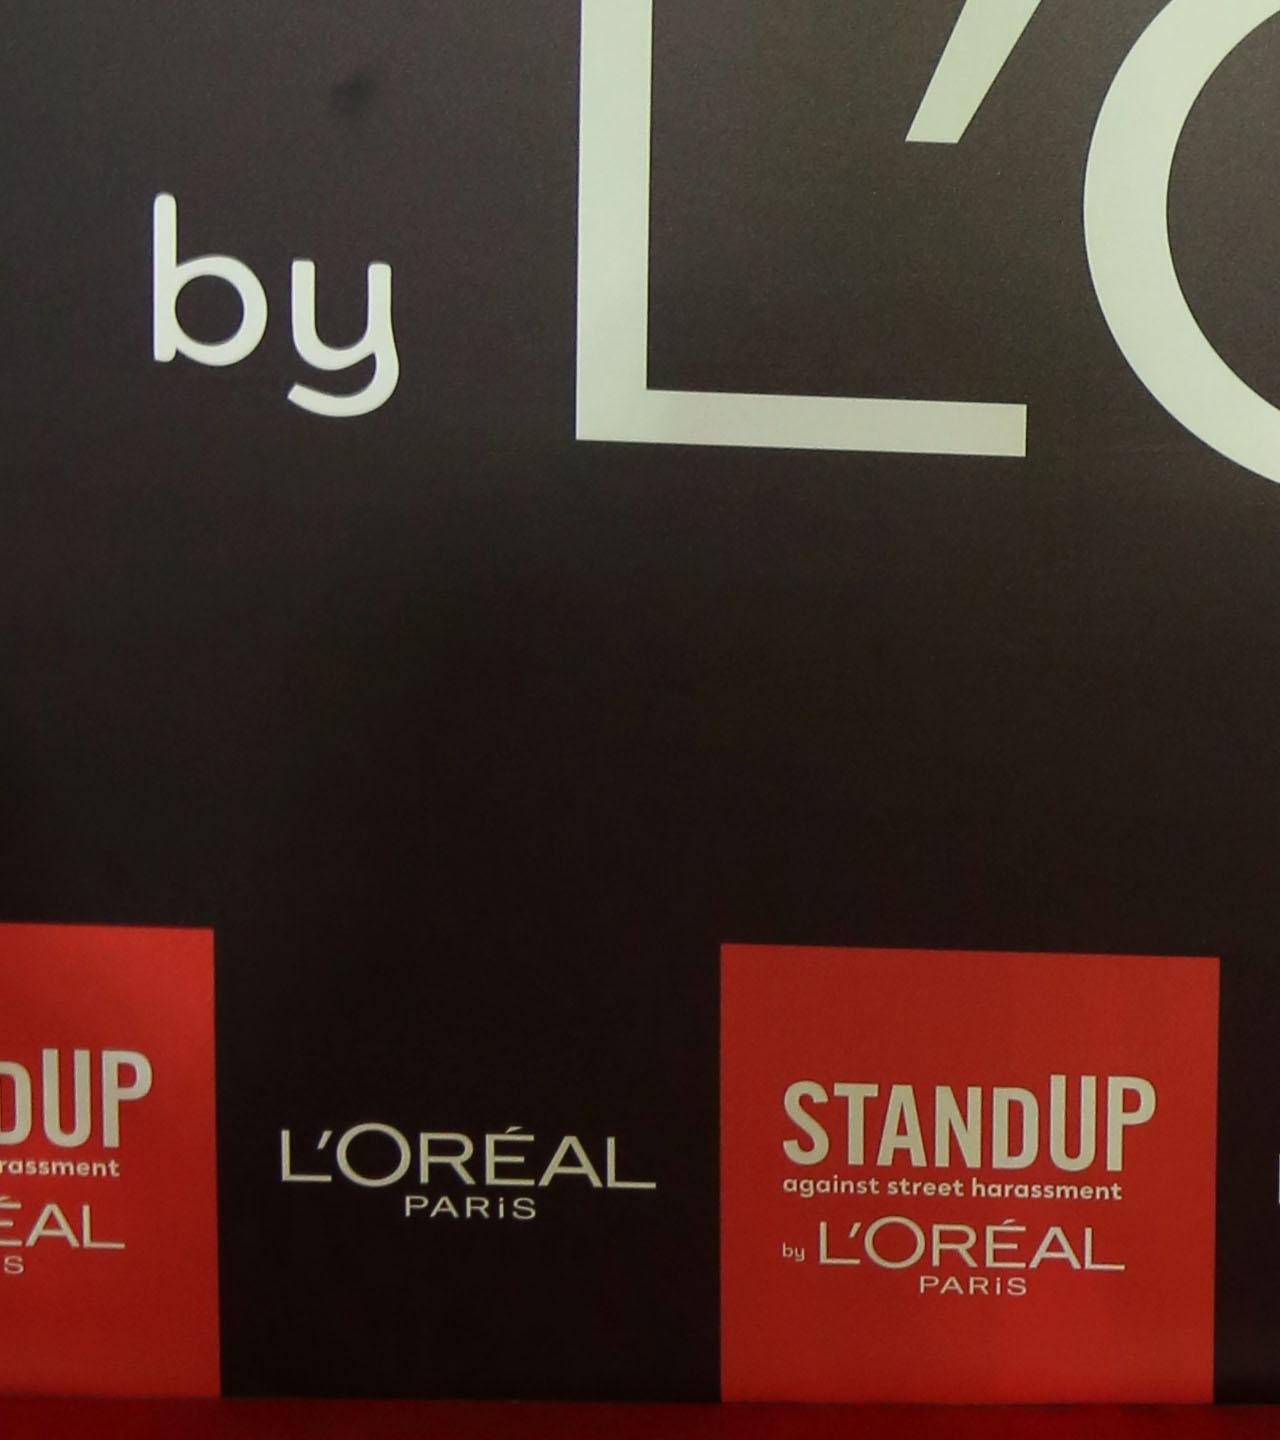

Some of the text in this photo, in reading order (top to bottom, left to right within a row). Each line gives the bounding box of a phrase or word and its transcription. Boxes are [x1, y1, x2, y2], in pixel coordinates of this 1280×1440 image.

[154, 193, 399, 417] by
[279, 1121, 658, 1190] L'ORÉAL
[781, 1073, 1157, 1173] STANDUP
[781, 1173, 1124, 1202] against street harassment
[781, 1214, 1127, 1272] by L'ORÉAL
